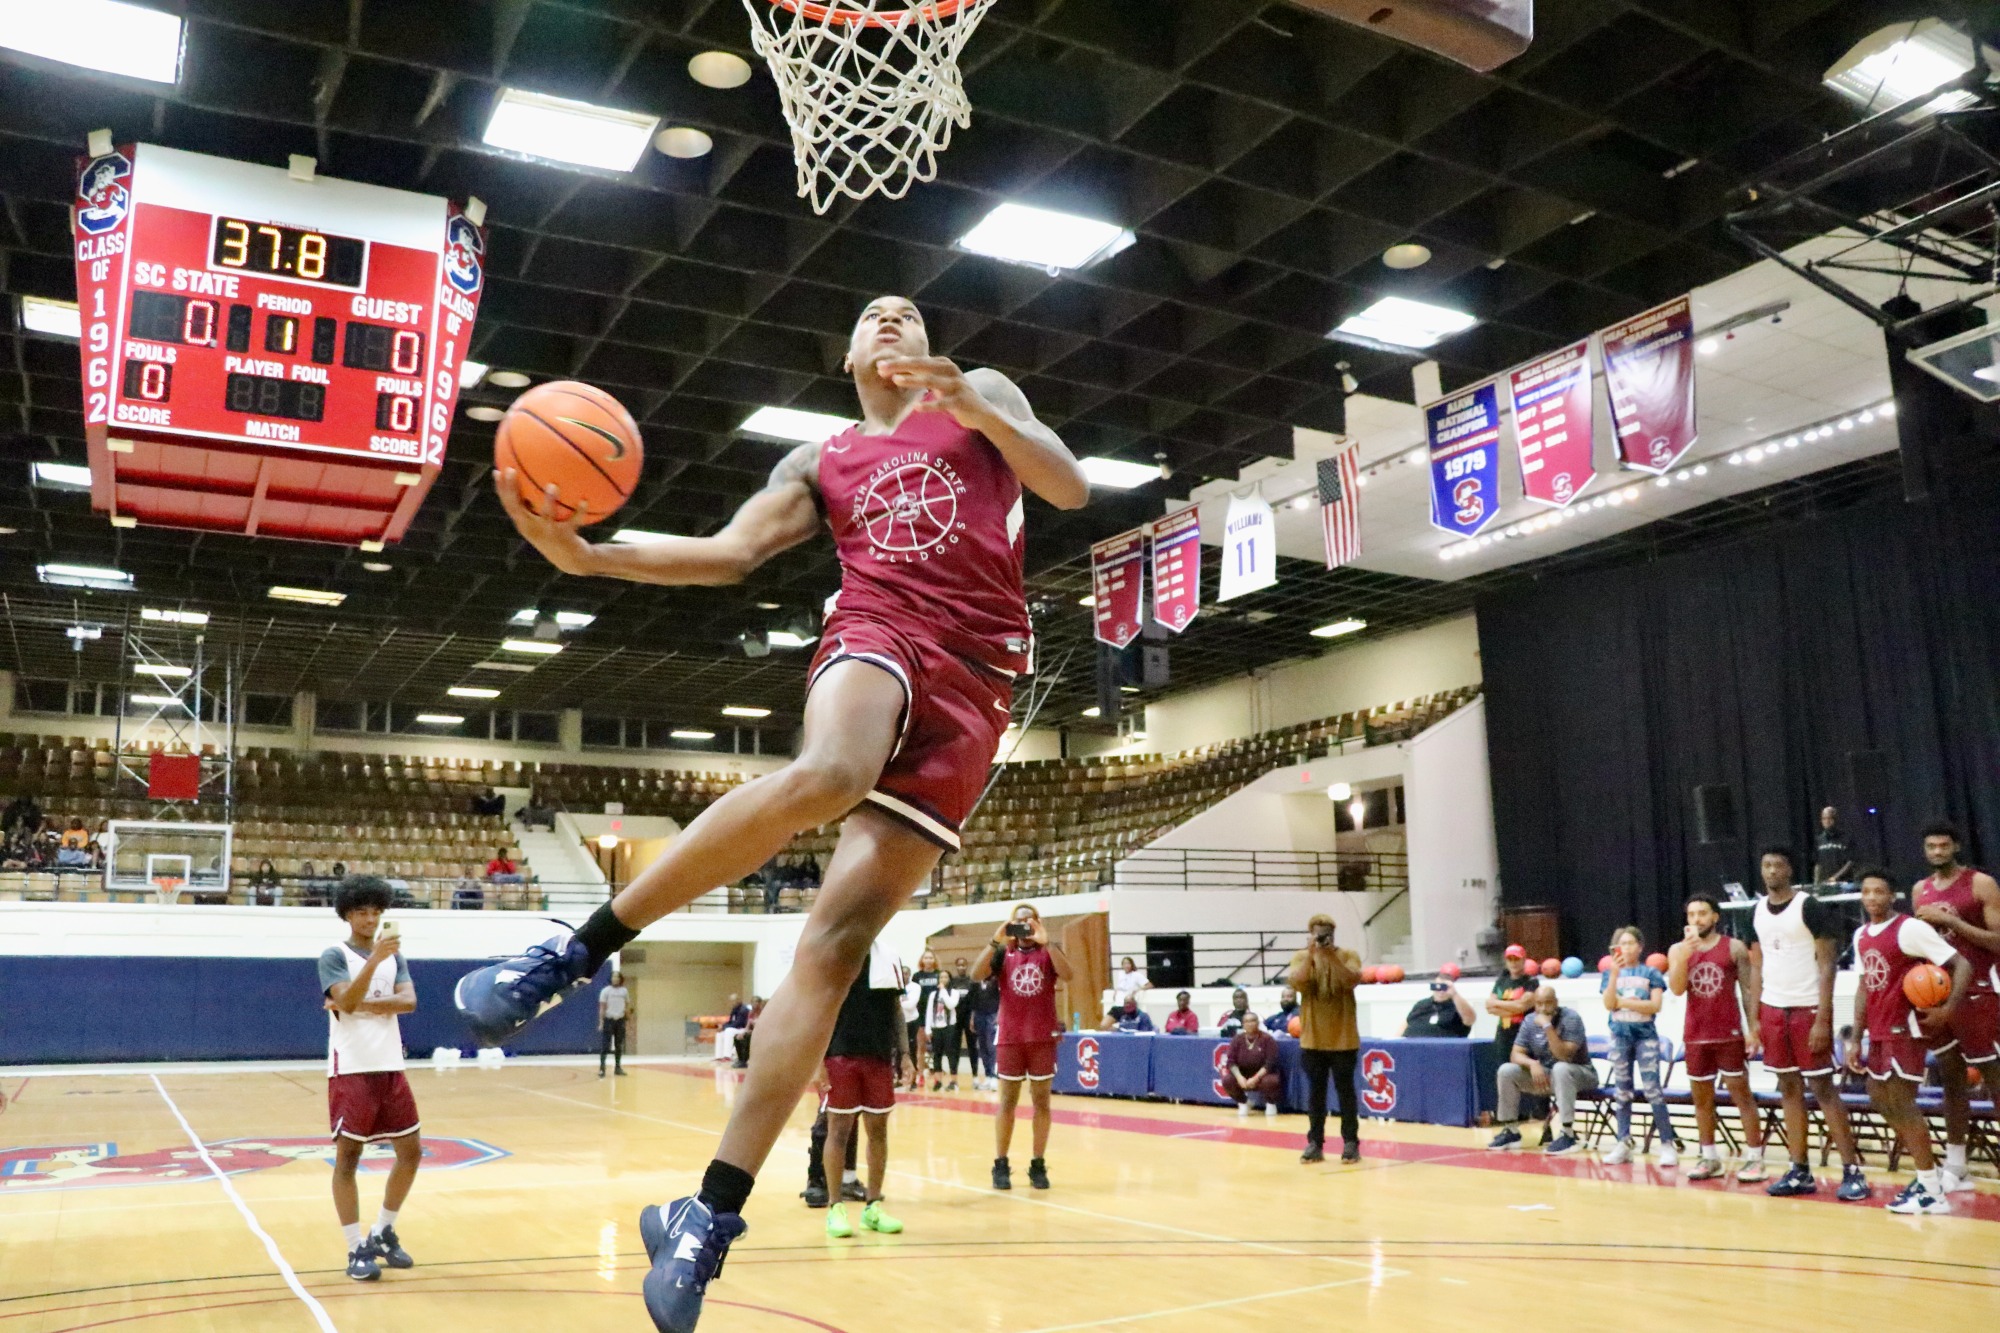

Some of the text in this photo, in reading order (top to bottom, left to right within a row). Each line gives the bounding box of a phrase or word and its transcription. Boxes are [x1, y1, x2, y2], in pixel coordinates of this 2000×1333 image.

[78, 232, 125, 262] CLASS
[221, 220, 327, 279] 37.8
[91, 259, 111, 282] OF
[134, 261, 240, 299] SC STATE
[257, 292, 313, 315] PERIOD
[351, 295, 423, 325] GUEST
[440, 284, 475, 322] CLASS
[184, 299, 213, 344] 0
[282, 319, 295, 352] 1
[446, 317, 463, 337] OF
[125, 342, 177, 364] FOULS
[391, 330, 421, 375] 0
[141, 363, 166, 400] 0
[225, 355, 331, 385] PLAYER FOUL
[375, 376, 424, 398] FOULS
[116, 403, 171, 426] SCORE
[391, 396, 414, 431] 0
[245, 419, 300, 441] MATCH
[369, 435, 420, 456] SCORE
[869, 451, 929, 483] CAROLINA
[934, 458, 967, 494] STATE
[1444, 449, 1487, 481] 1979
[1227, 512, 1262, 535] WILLIAMS
[1236, 537, 1255, 577] 11
